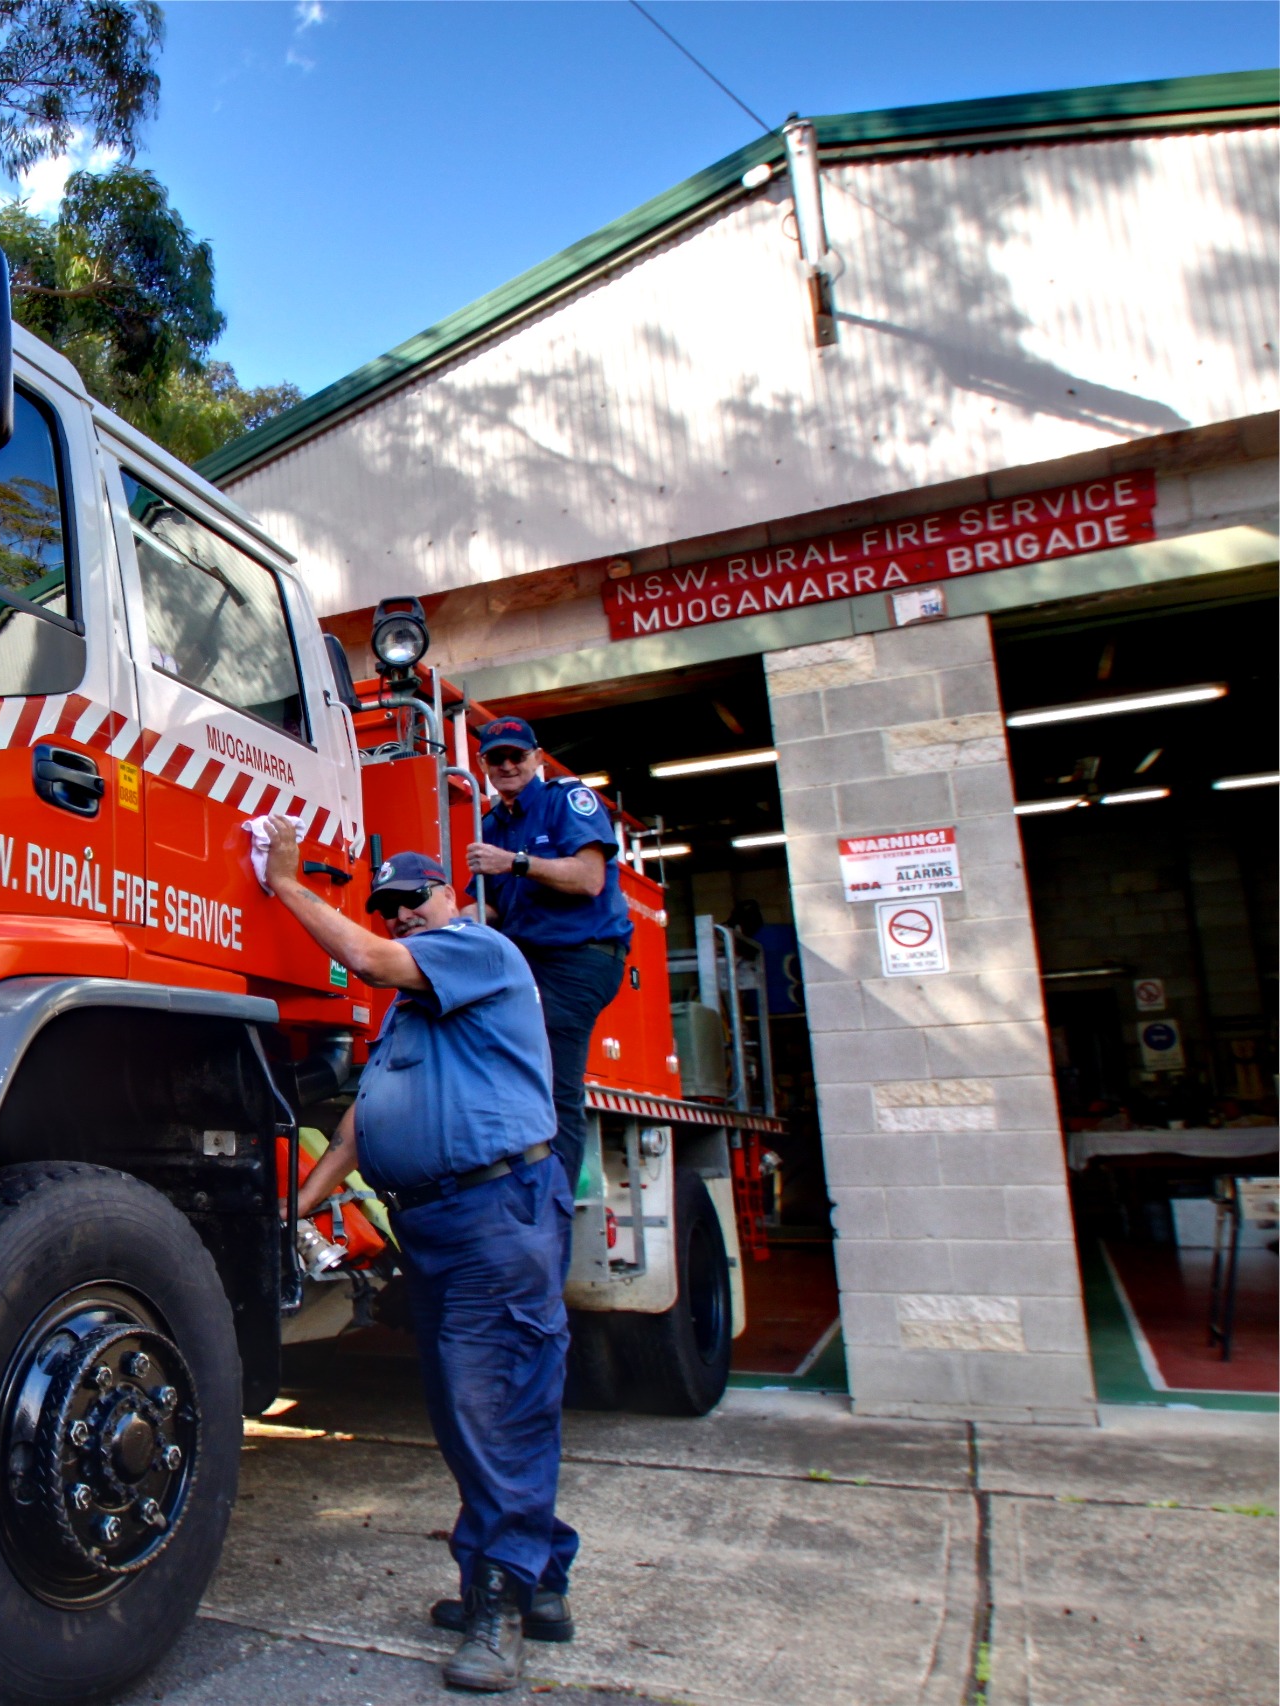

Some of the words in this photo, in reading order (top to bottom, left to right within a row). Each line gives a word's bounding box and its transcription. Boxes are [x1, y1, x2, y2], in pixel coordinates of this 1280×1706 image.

[616, 565, 718, 606] N.S.W.
[727, 540, 848, 583] RURAL
[862, 517, 944, 556] FIRE
[959, 478, 1138, 536] SERVICE
[632, 561, 909, 633] MUOGAMARRA
[946, 514, 1130, 574] BRIGADE
[206, 723, 296, 787] MUOGAMARRA
[847, 830, 947, 854] WARNING!
[896, 866, 953, 881] ALARMS
[26, 842, 107, 914] RURAL
[113, 869, 159, 928] FIRE
[164, 885, 243, 951] SERVICE
